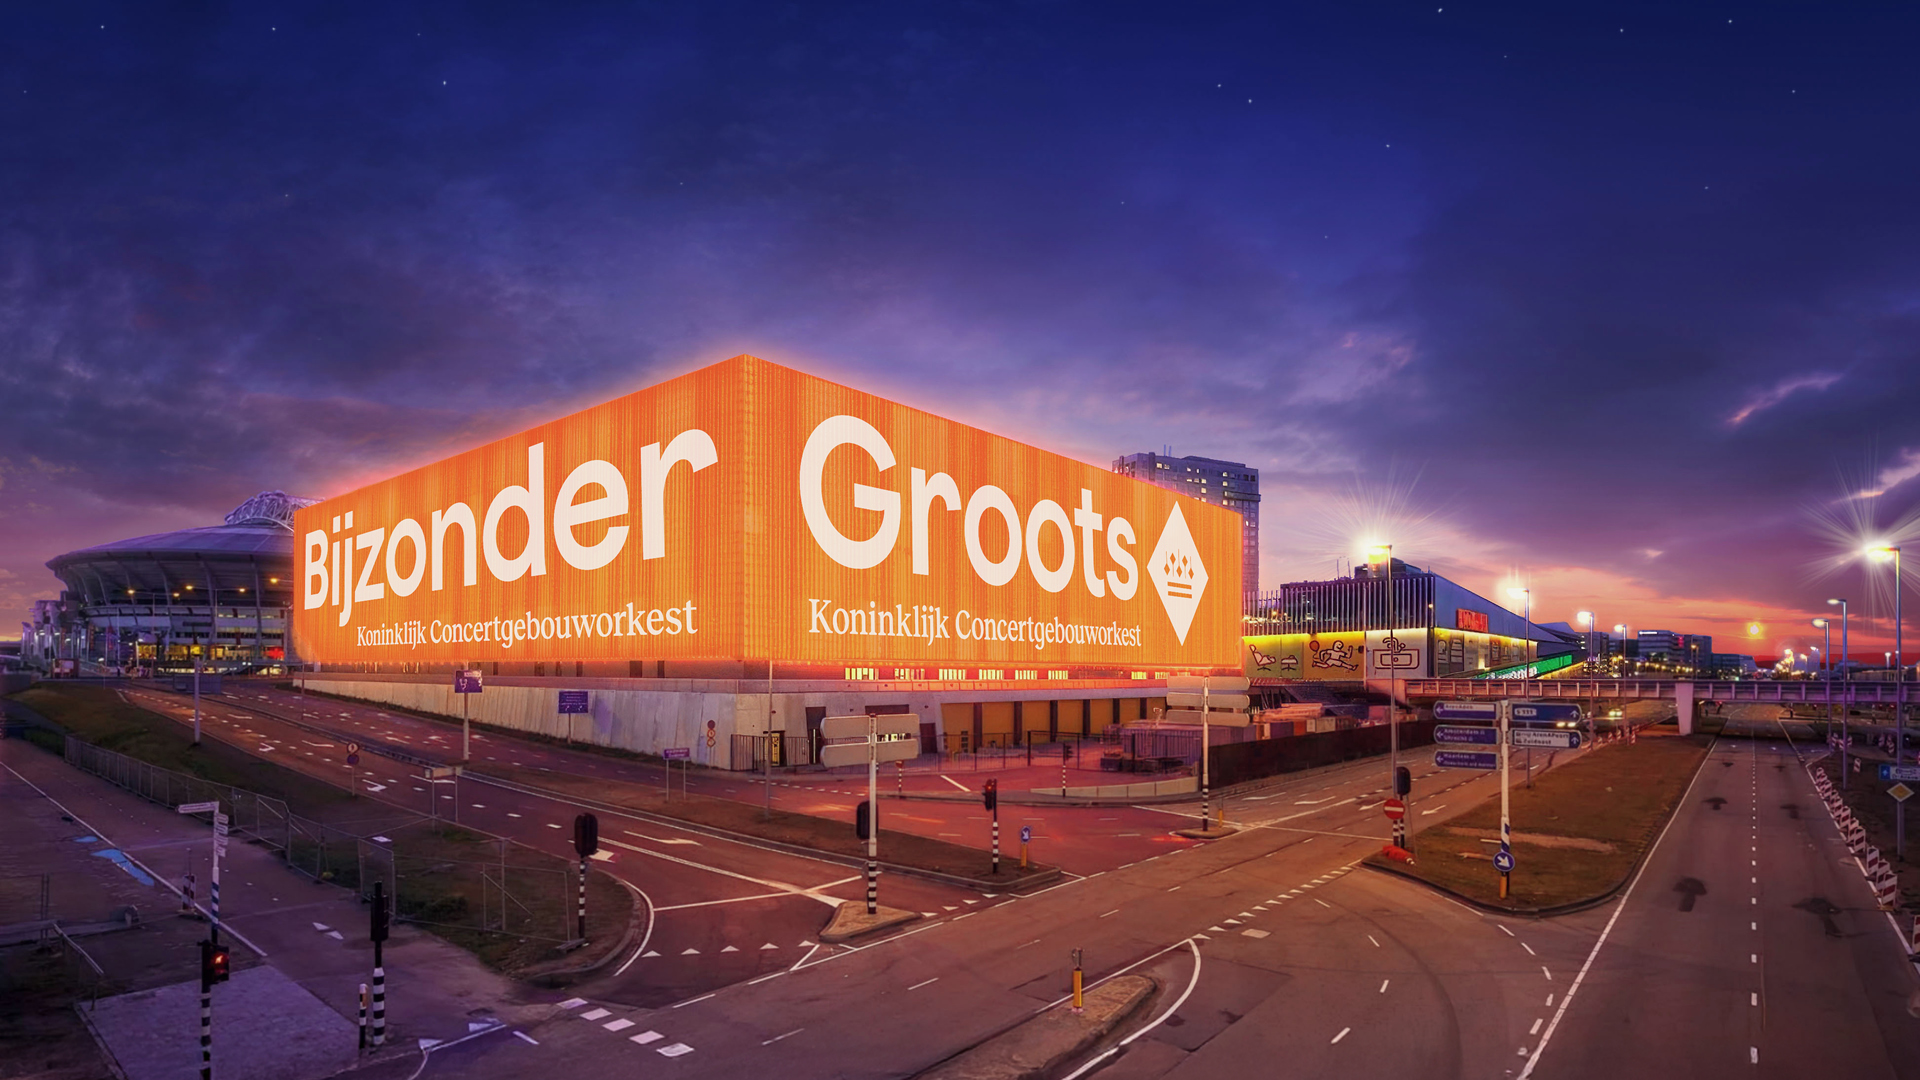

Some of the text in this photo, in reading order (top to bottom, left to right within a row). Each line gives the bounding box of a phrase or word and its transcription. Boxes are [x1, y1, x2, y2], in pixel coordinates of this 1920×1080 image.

[304, 429, 718, 626] Bijzonder
[800, 415, 1138, 600] Groots
[357, 600, 698, 650] Koninklijk Concertgebouworkest
[808, 598, 1142, 649] Koninklijk Concertgebouworkest
